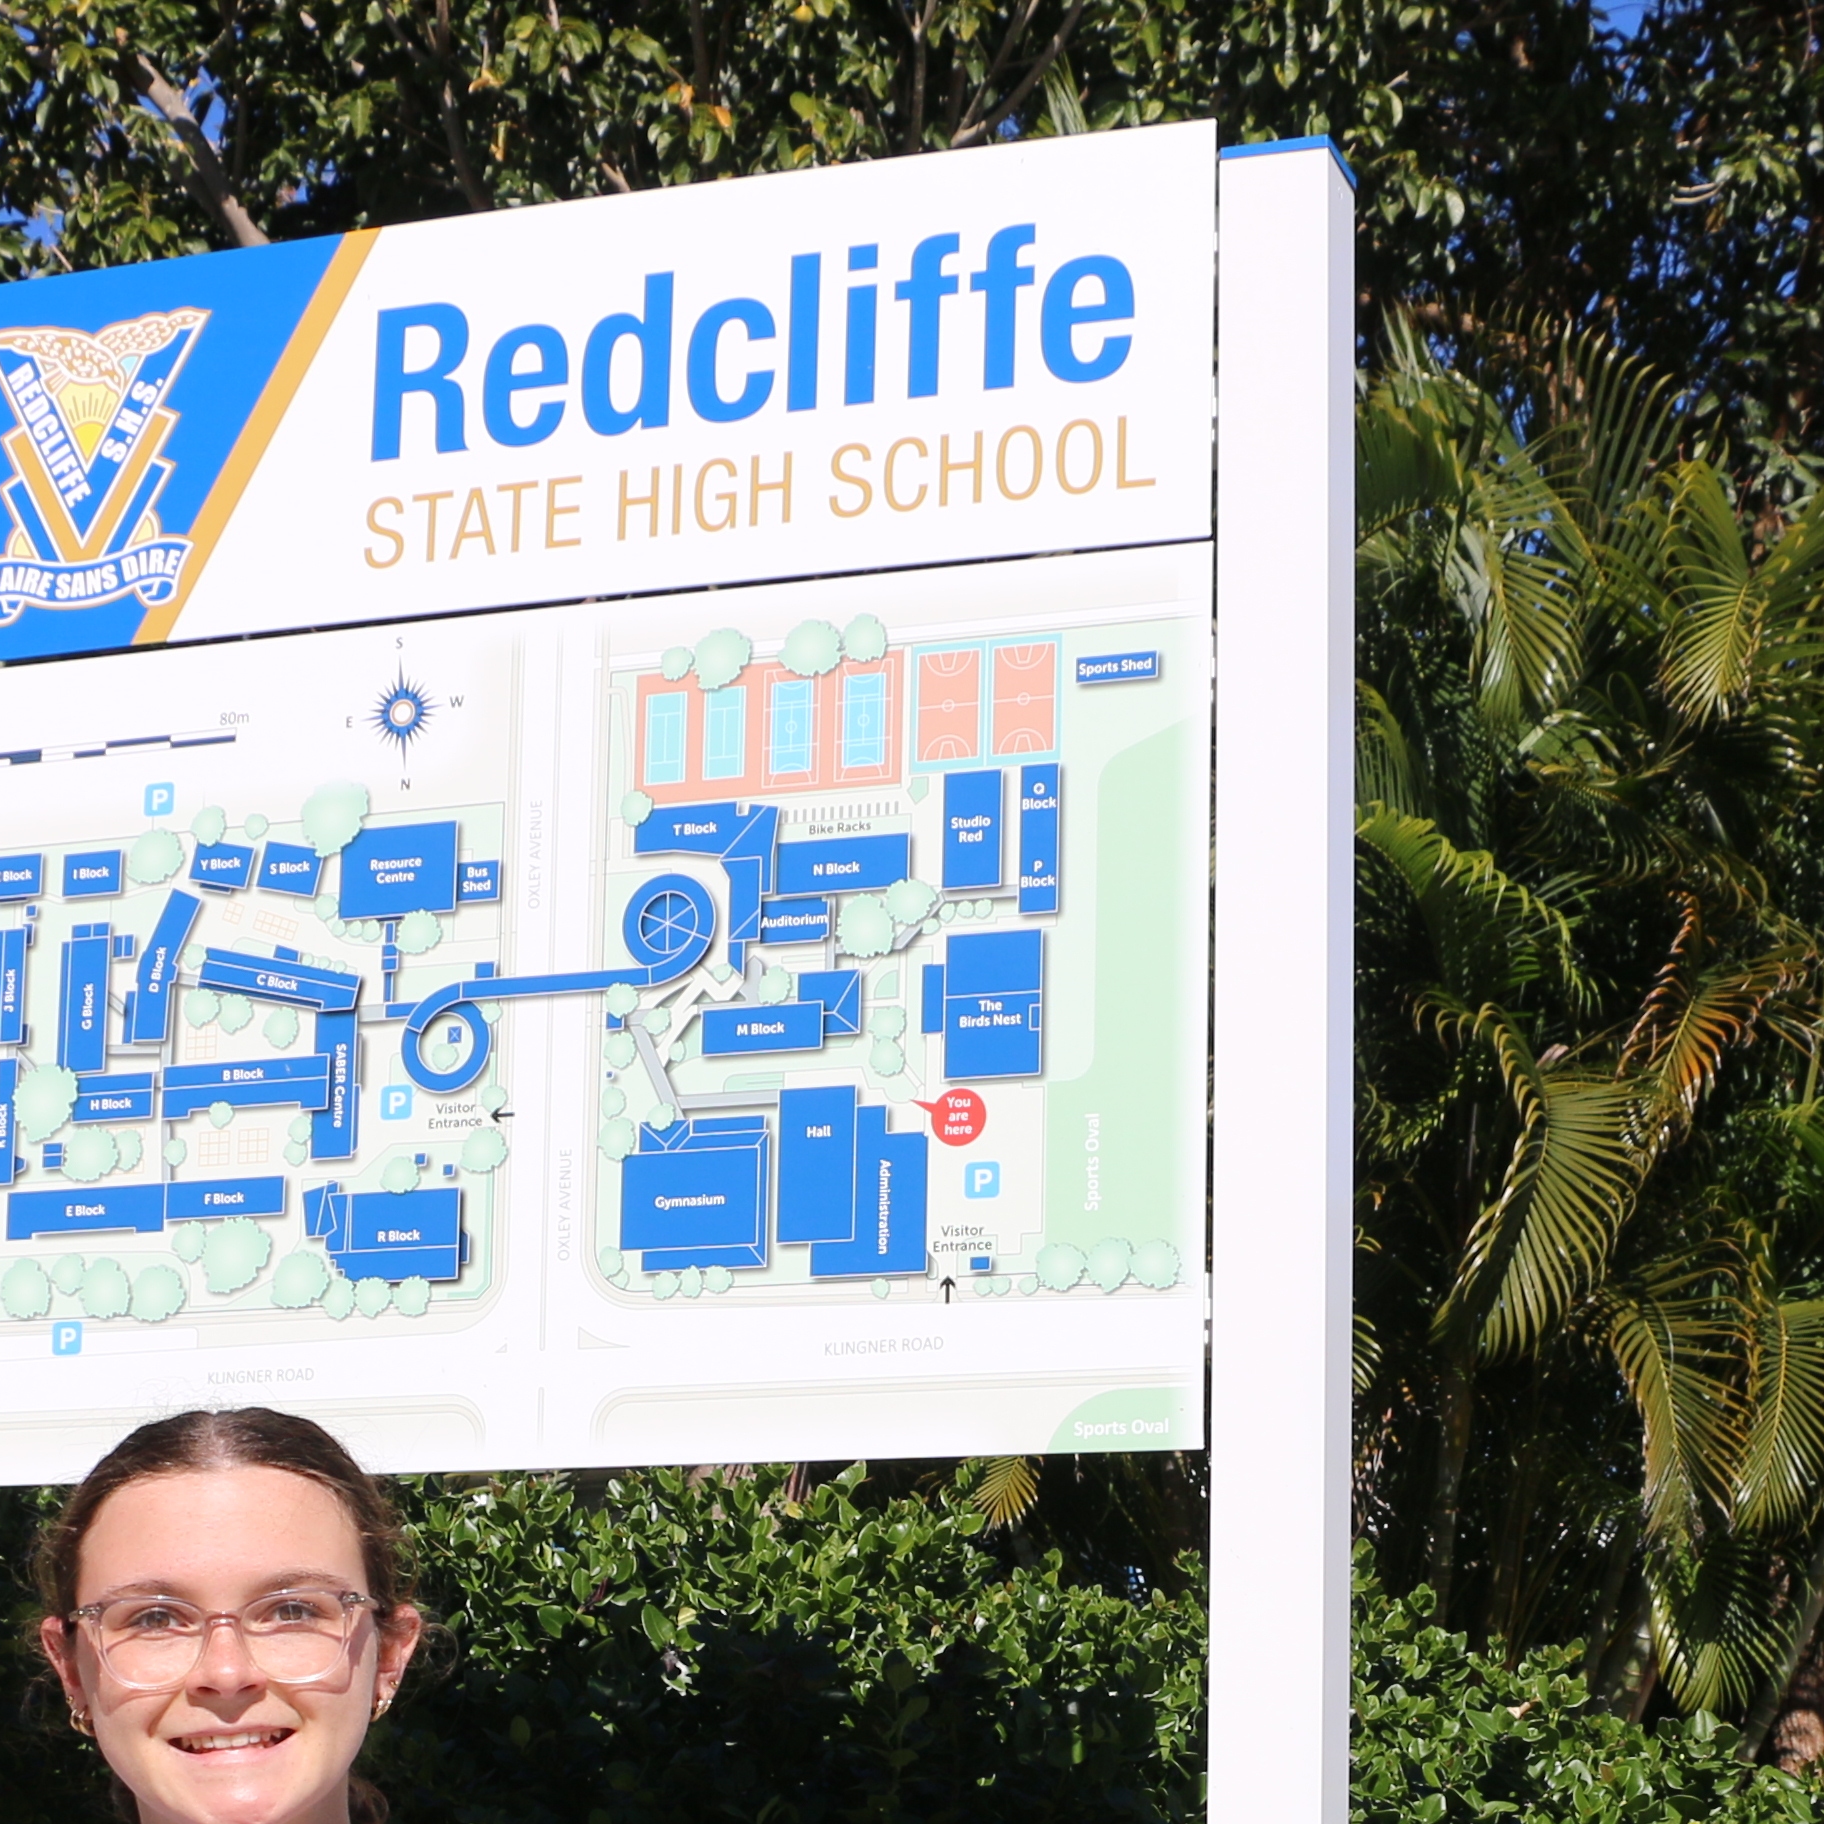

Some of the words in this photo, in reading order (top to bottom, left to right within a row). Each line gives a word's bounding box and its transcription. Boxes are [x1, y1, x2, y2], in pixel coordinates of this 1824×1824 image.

[370, 222, 1136, 462] Redcliffe
[6, 361, 92, 509] REDCLIFFE
[100, 377, 164, 464] S.H.S.
[363, 475, 584, 570] STATE
[616, 450, 795, 542] HIGH
[828, 415, 1158, 519] SCHOOL
[54, 563, 118, 599] SANS
[120, 549, 182, 582] DIRE
[395, 636, 404, 649] S
[1078, 660, 1119, 677] Sports
[1121, 657, 1153, 671] Shed
[449, 695, 464, 708] W
[219, 712, 250, 727] 80m
[345, 716, 353, 728] E
[400, 778, 411, 791] N
[1022, 796, 1057, 811] Block
[673, 824, 683, 836] T
[684, 821, 717, 835] Block
[808, 823, 834, 836] Bike
[837, 820, 872, 833] Racks
[950, 815, 991, 829] Studio
[529, 800, 543, 860] AVENUE
[958, 830, 983, 844] Red
[200, 859, 210, 871] Y
[210, 856, 241, 871] Block
[269, 863, 278, 875] S
[278, 860, 310, 875] Block
[370, 857, 423, 871] Resource
[813, 864, 824, 876] N
[825, 861, 860, 876] Block
[1033, 860, 1043, 873] P
[3, 869, 33, 882] Block
[79, 866, 109, 880] Block
[375, 871, 415, 884] Centre
[466, 866, 488, 878] Bus
[462, 879, 491, 893] Shed
[528, 863, 541, 909] OXLEY
[1020, 874, 1055, 888] Block
[761, 913, 829, 929] Auditorium
[150, 946, 167, 981] Block
[4, 968, 16, 1004] Block
[148, 982, 160, 993] D
[256, 974, 266, 986] C
[267, 976, 298, 991] Block
[81, 983, 94, 1018] Block
[978, 999, 1003, 1012] The
[81, 1019, 93, 1030] G
[959, 1014, 991, 1028] Birds
[993, 1013, 1022, 1026] Nest
[736, 1024, 749, 1036] M
[750, 1021, 785, 1036] Block
[334, 1043, 347, 1084] SABER
[222, 1069, 232, 1081] B
[233, 1067, 264, 1081] Block
[89, 1100, 101, 1111] H
[101, 1097, 132, 1111] Block
[332, 1085, 346, 1129] Centre
[436, 1101, 476, 1115] Visitor
[946, 1096, 971, 1109] You
[428, 1115, 483, 1130] Entrance
[948, 1111, 969, 1122] are
[806, 1125, 831, 1138] Hall
[944, 1124, 973, 1136] here
[1084, 1112, 1100, 1152] Oval
[558, 1149, 572, 1210] AVENUE
[1084, 1155, 1100, 1212] Sports
[204, 1193, 212, 1205] F
[212, 1191, 245, 1205] Block
[654, 1193, 726, 1211] Gymnasium
[65, 1205, 74, 1217] E
[74, 1203, 106, 1217] Block
[877, 1159, 892, 1255] Administration
[377, 1231, 387, 1243] R
[388, 1228, 421, 1242] Block
[557, 1215, 571, 1261] OXLEY
[941, 1225, 985, 1238] Visitor
[932, 1238, 993, 1253] Entrance
[824, 1338, 898, 1357] KLINGNER
[901, 1335, 945, 1352] ROAD
[207, 1369, 273, 1385] KLINGNER
[276, 1367, 315, 1382] ROAD
[1073, 1420, 1127, 1440] Sports
[1131, 1418, 1170, 1435] Oval
